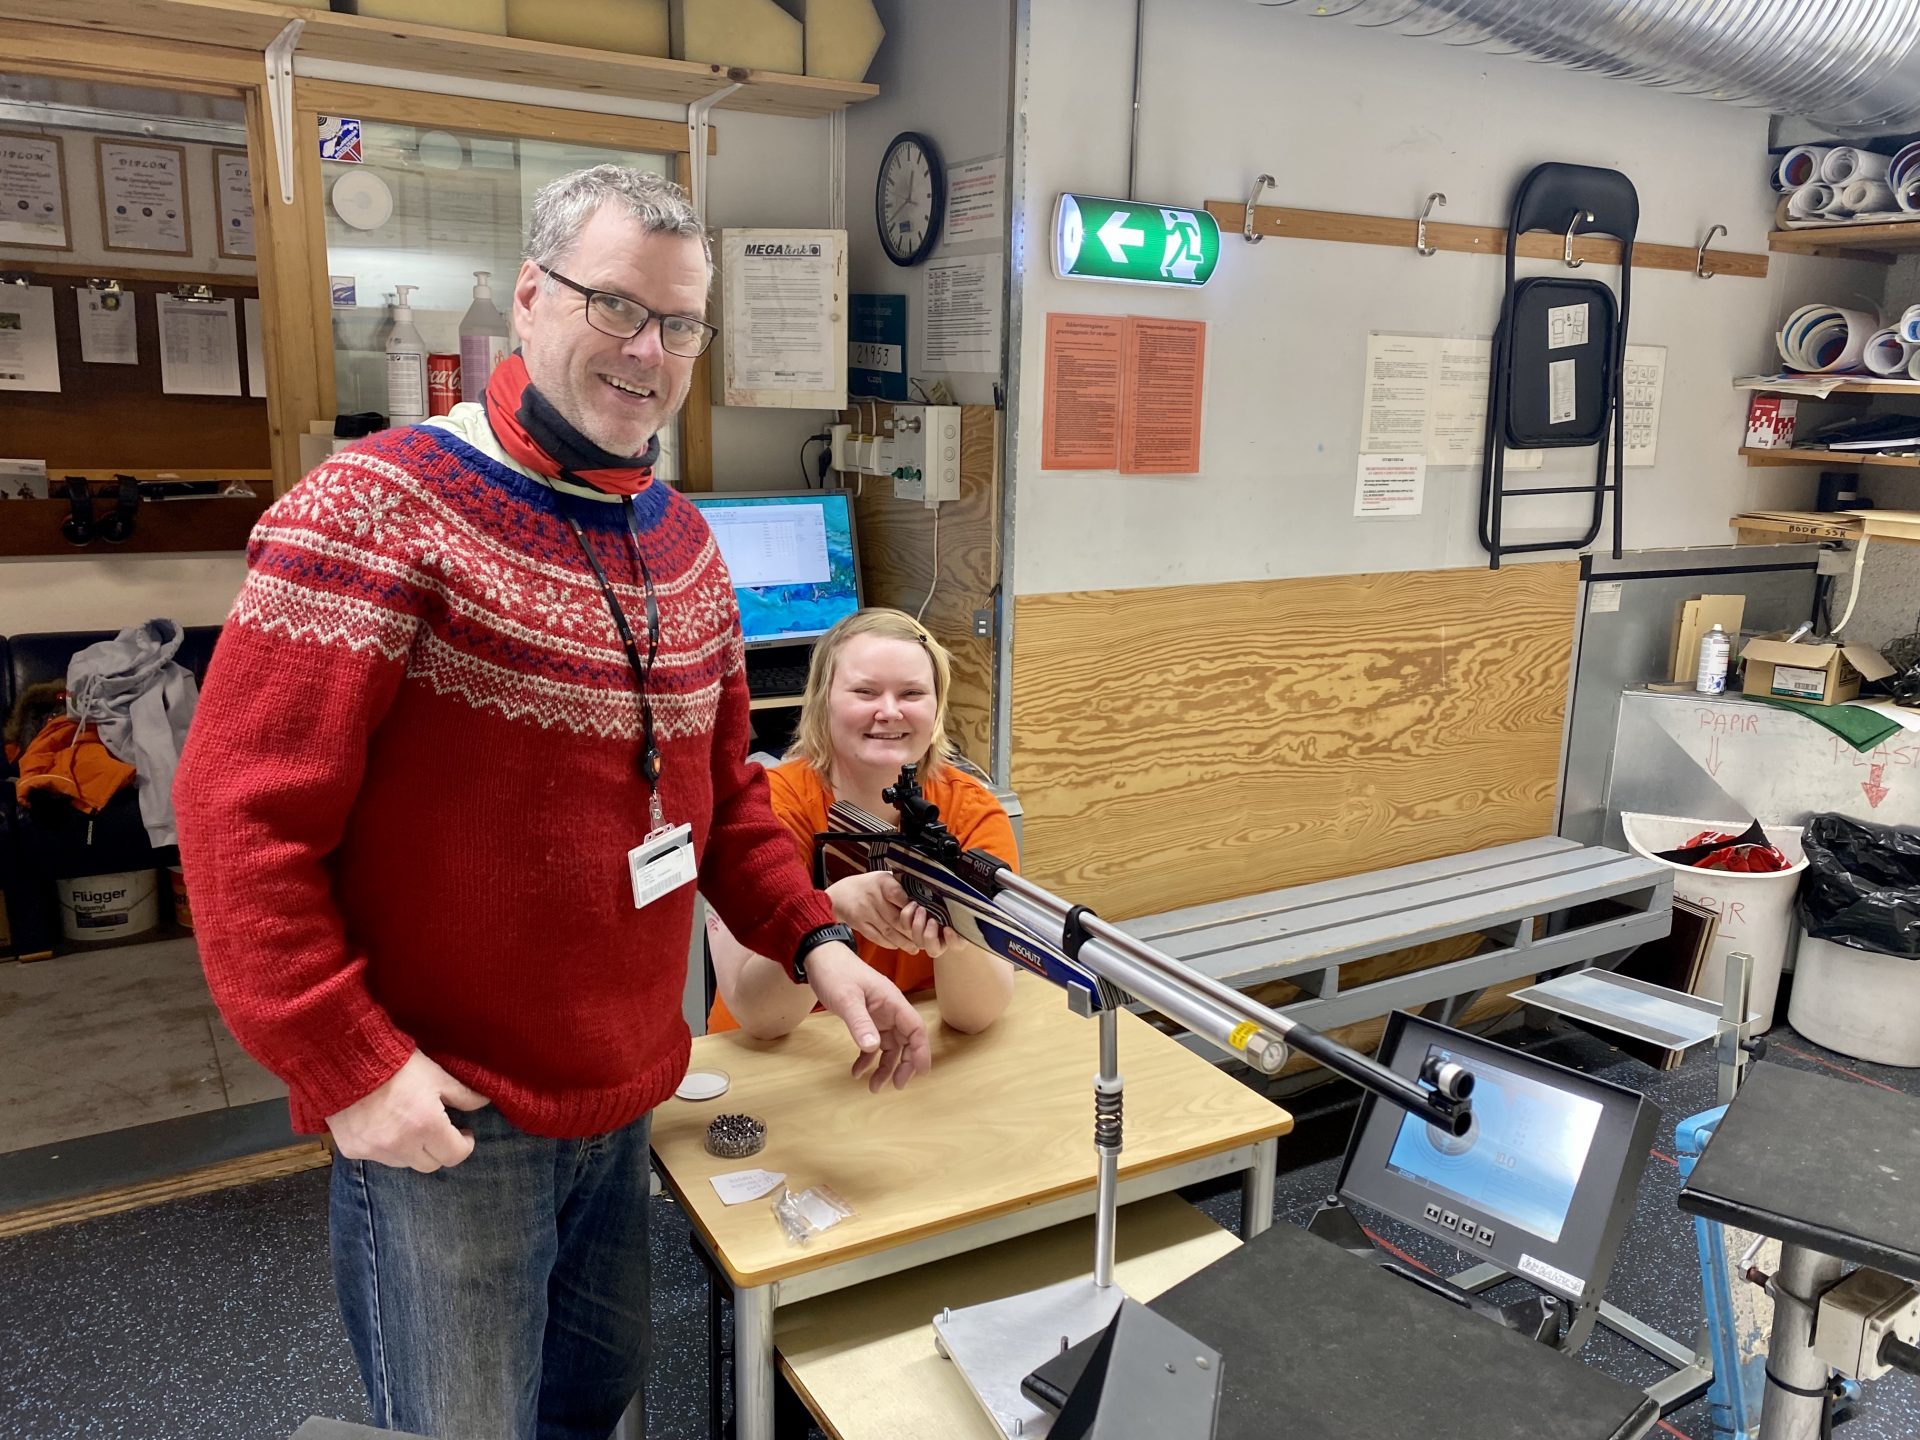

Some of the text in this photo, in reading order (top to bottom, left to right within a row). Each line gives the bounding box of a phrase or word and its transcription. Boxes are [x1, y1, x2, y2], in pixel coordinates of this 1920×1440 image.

[0, 150, 44, 161] IPLOM
[119, 158, 168, 170] DIPLOM
[744, 244, 808, 255] MEGAlink
[857, 345, 889, 366] 21953
[1695, 708, 1759, 734] PAPIR
[973, 860, 992, 877] 9015
[72, 889, 127, 903] Flügger
[1674, 891, 1746, 925] PIR
